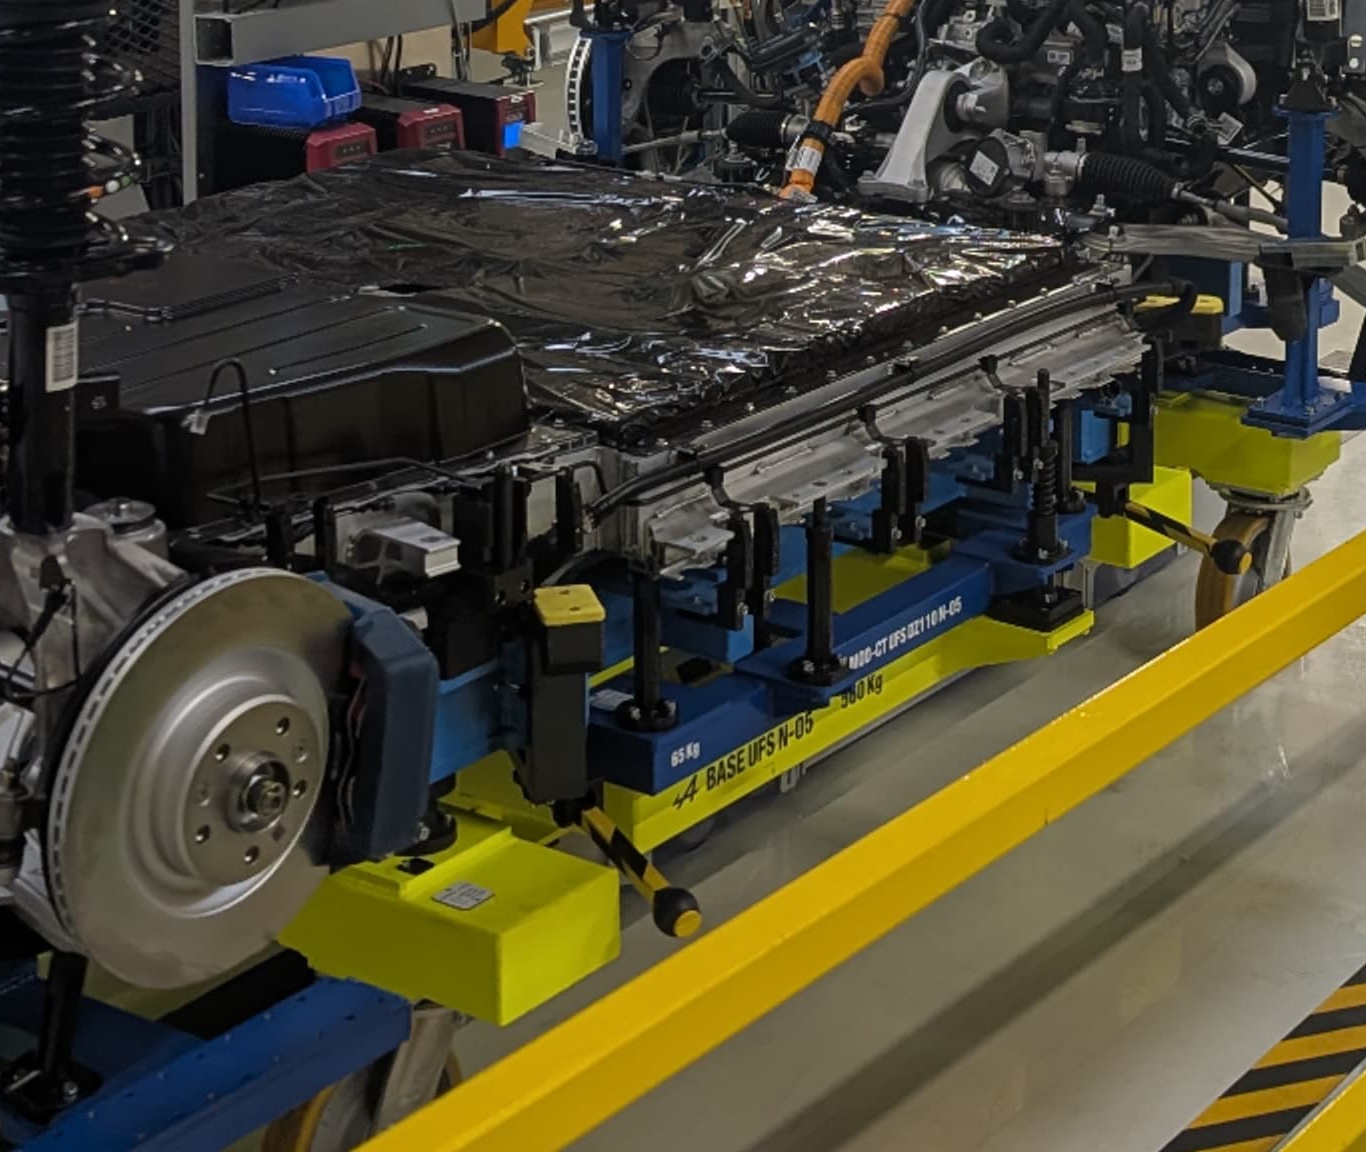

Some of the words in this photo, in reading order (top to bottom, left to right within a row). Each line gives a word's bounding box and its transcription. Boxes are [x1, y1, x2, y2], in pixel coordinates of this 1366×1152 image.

[867, 673, 883, 696] Kg
[670, 747, 685, 768] 65
[705, 748, 747, 792] BASE
[748, 731, 776, 768] UFS
[778, 710, 815, 751] N-05
